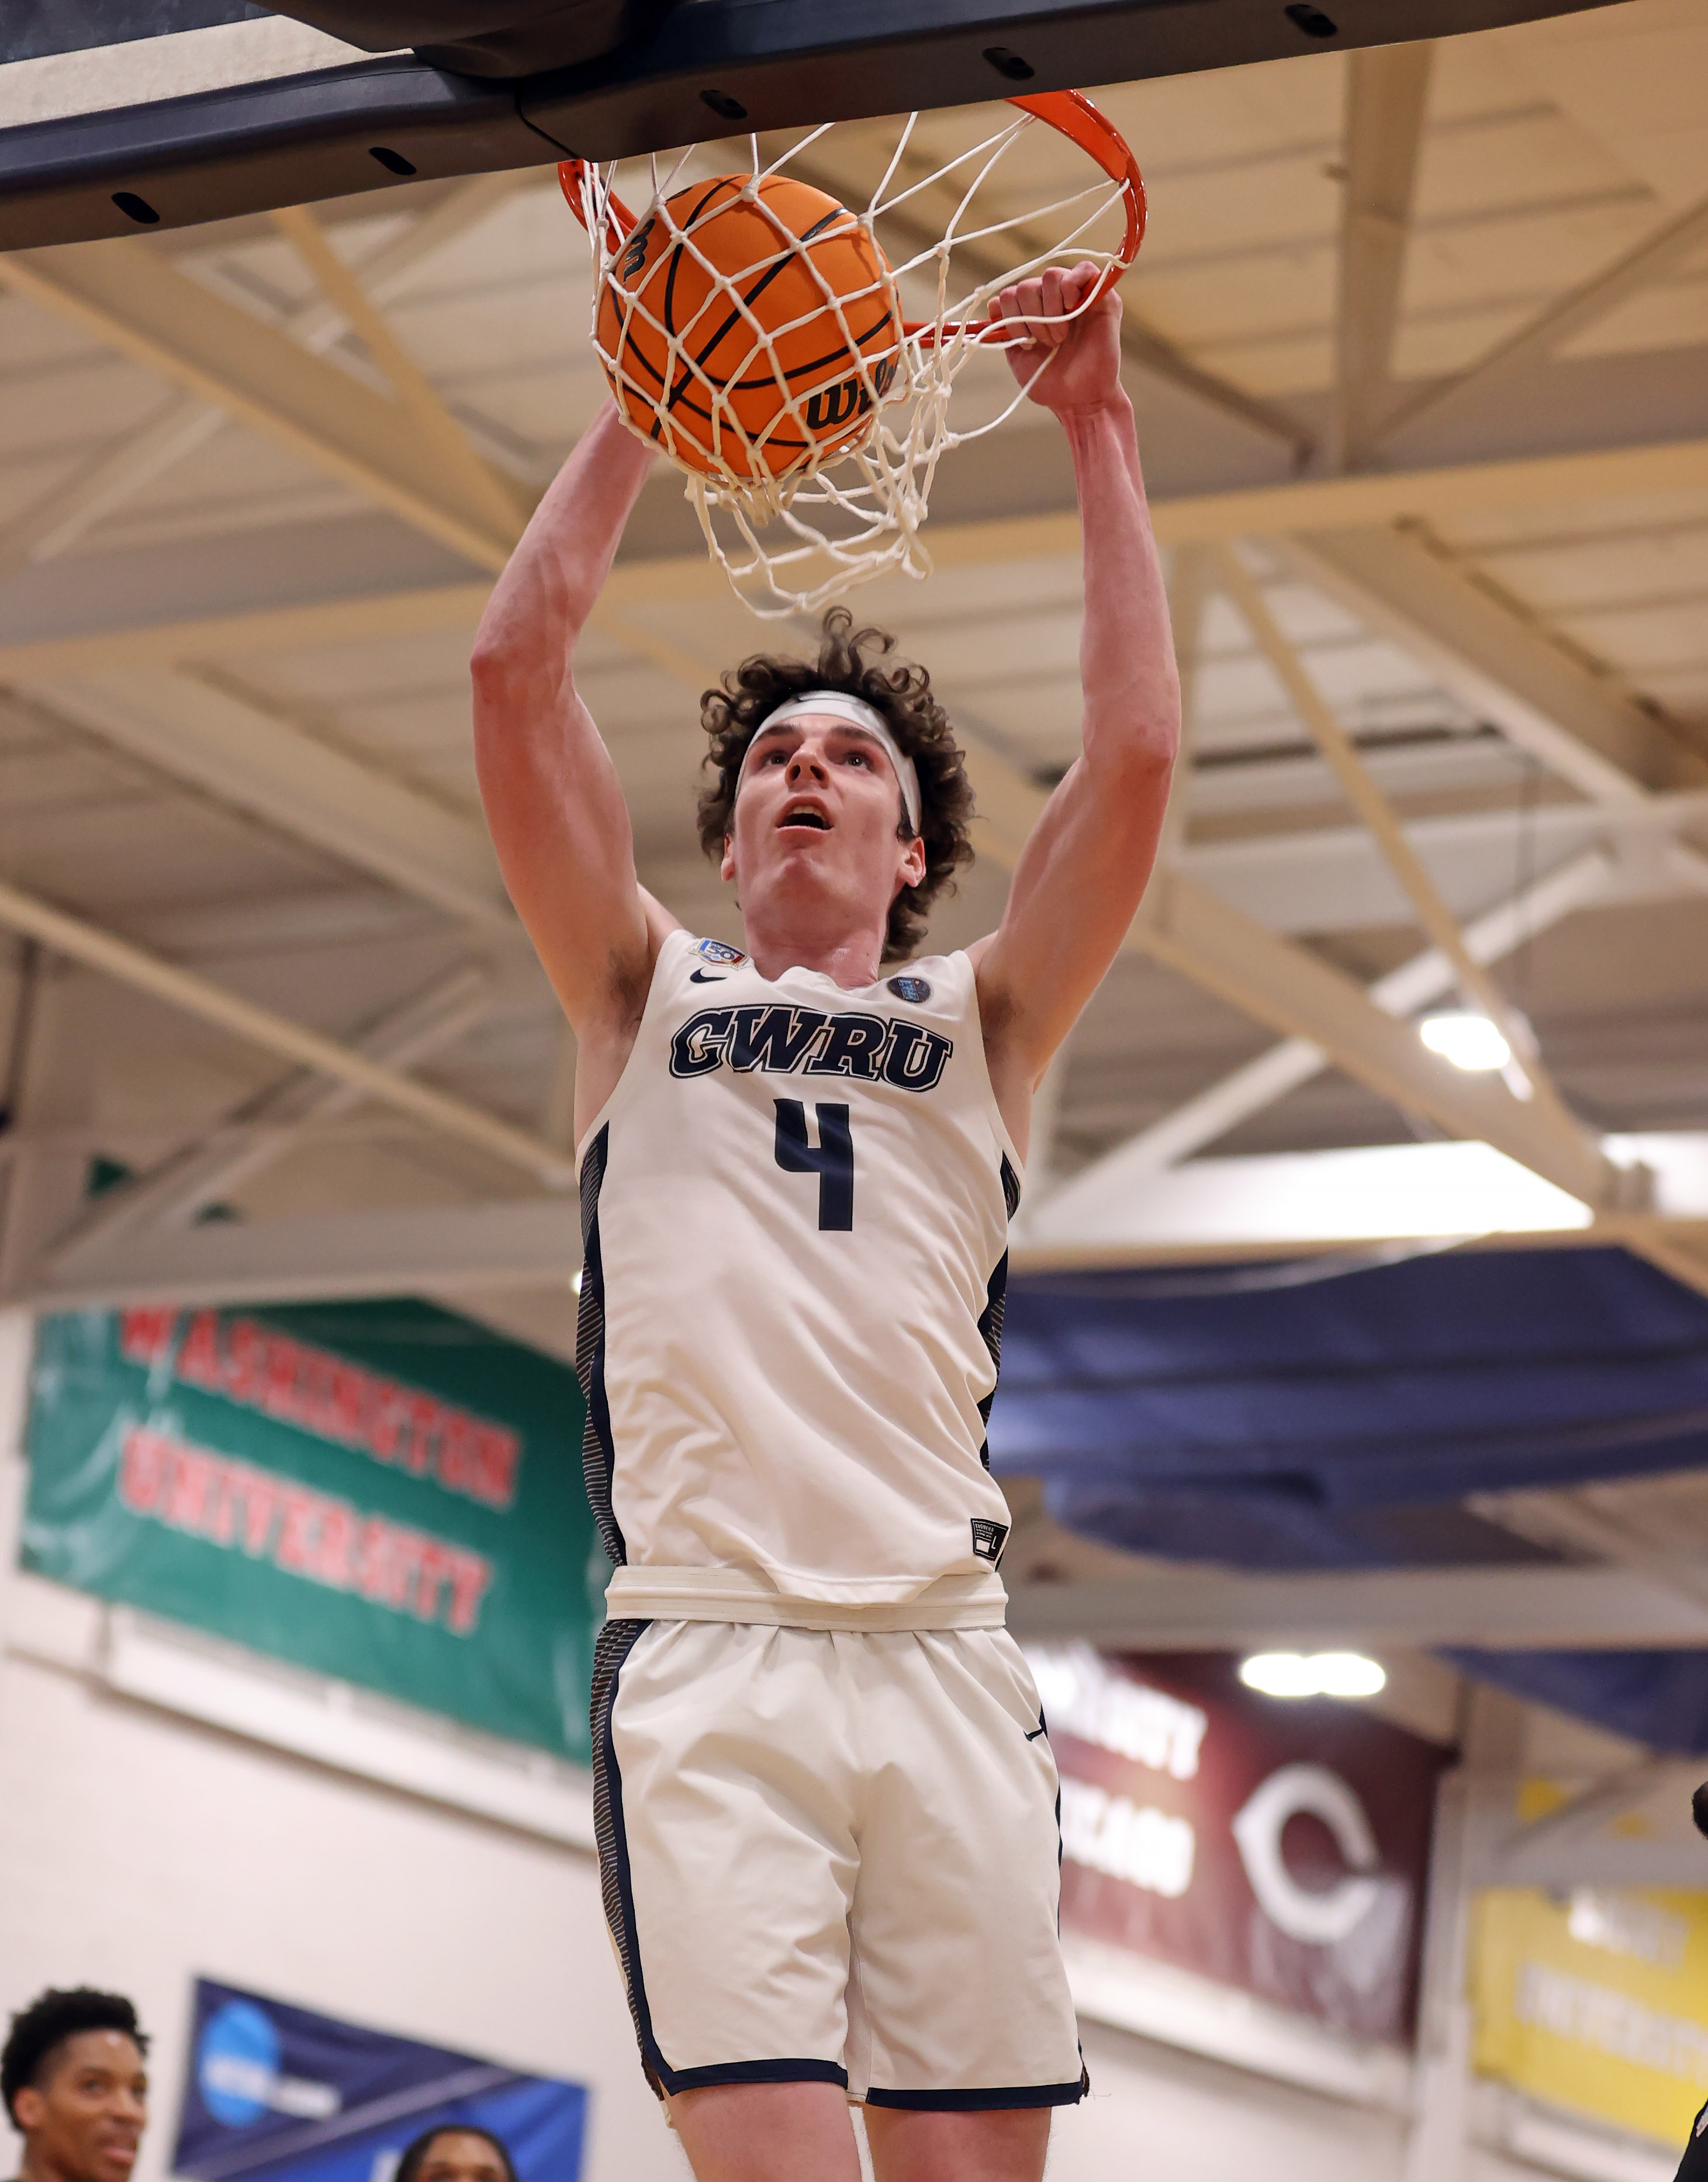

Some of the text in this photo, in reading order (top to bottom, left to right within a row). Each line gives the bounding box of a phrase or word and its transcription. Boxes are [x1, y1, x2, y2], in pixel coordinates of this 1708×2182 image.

[707, 945, 735, 960] 50
[669, 1004, 954, 1092] CWRU
[773, 1098, 854, 1232] 4
[120, 1307, 520, 1515] WASHINGTON
[119, 1423, 496, 1637] UNIVERSITY
[991, 1536, 997, 1549] L
